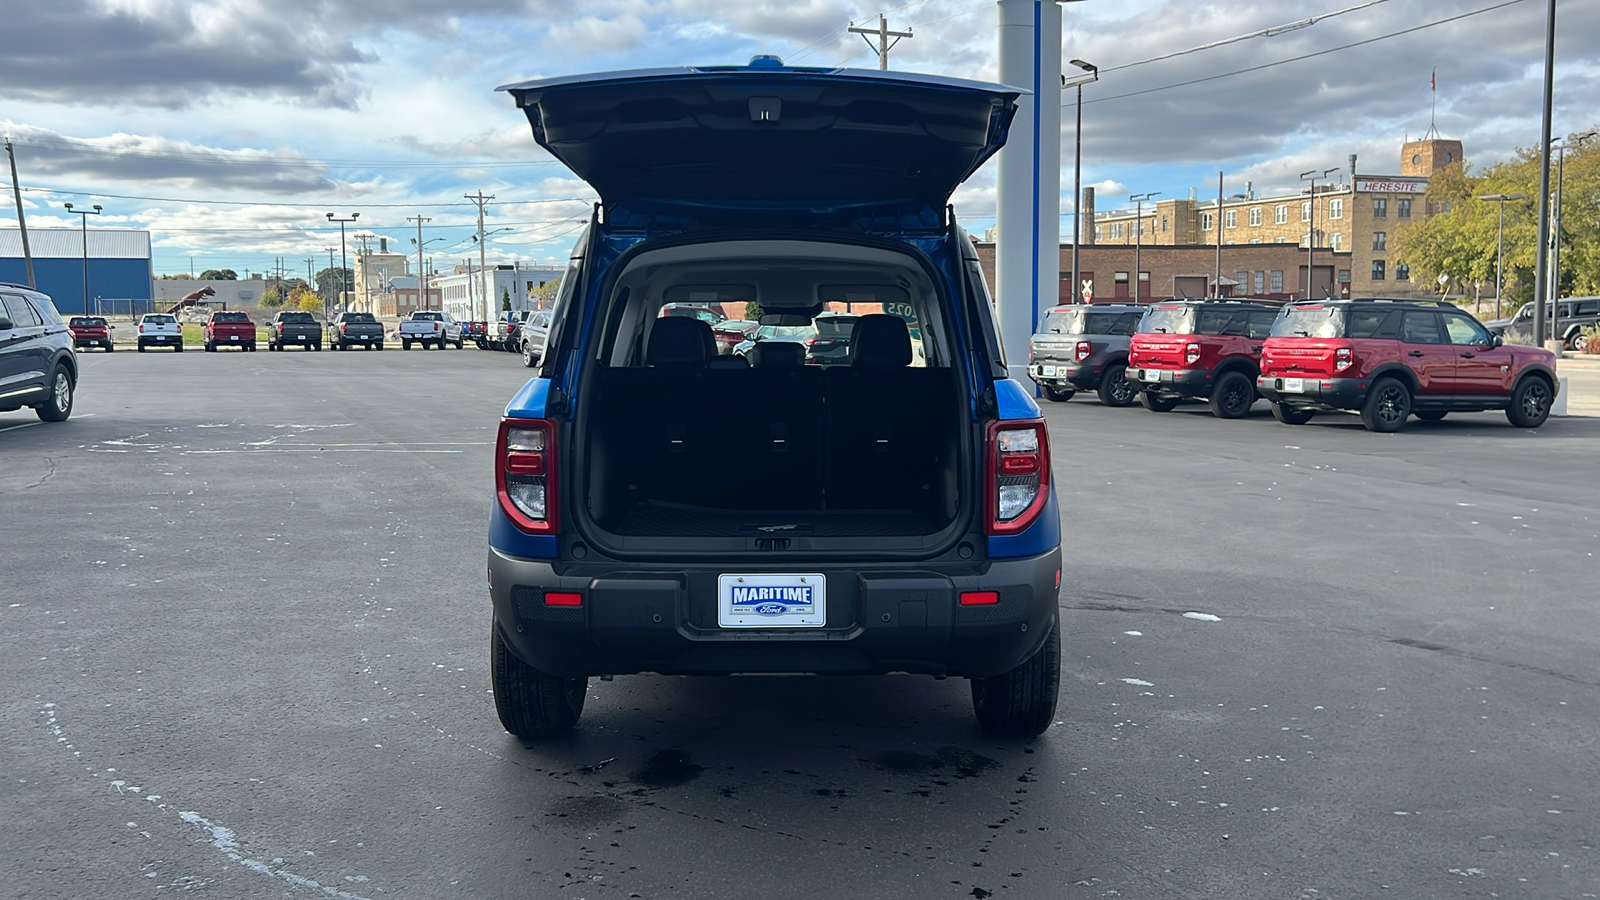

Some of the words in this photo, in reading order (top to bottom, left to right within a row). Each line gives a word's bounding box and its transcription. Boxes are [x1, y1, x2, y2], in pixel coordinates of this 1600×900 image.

[1364, 182, 1418, 192] HERESITE
[733, 587, 811, 604] MARITIME
[759, 605, 783, 614] Ford
